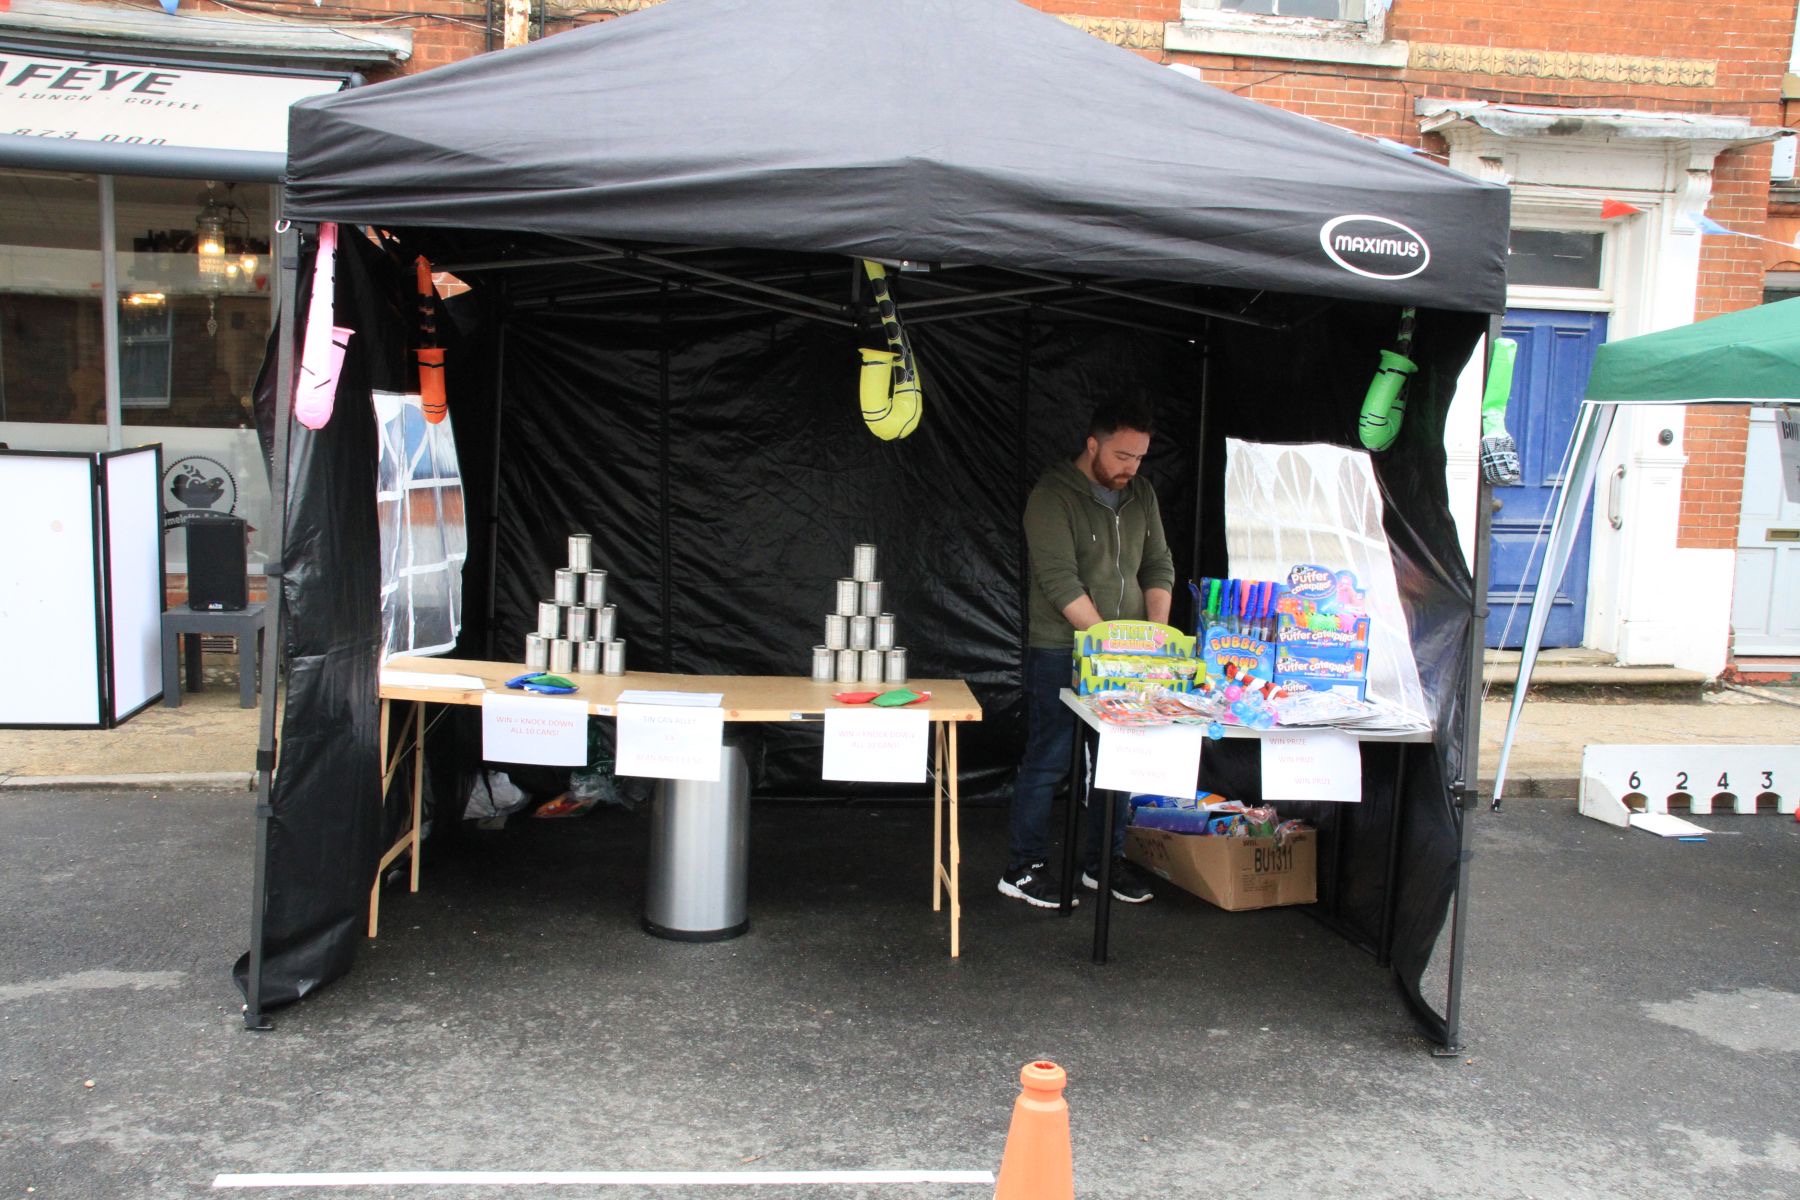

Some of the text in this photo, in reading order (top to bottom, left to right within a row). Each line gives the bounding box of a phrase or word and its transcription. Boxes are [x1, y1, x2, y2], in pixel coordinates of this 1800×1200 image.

[19, 92, 202, 110] LUNCH COFFEE
[1335, 235, 1419, 257] MAXIMUS
[1210, 635, 1268, 656] BUBBLE
[496, 715, 575, 728] WIN KNOCK DOWN
[511, 727, 523, 735] ALL
[1269, 737, 1307, 745] WIN PRIZE
[1629, 771, 1773, 790] 6 2 4 3
[1255, 846, 1293, 873] BU1311
[1016, 875, 1032, 888] FILA
